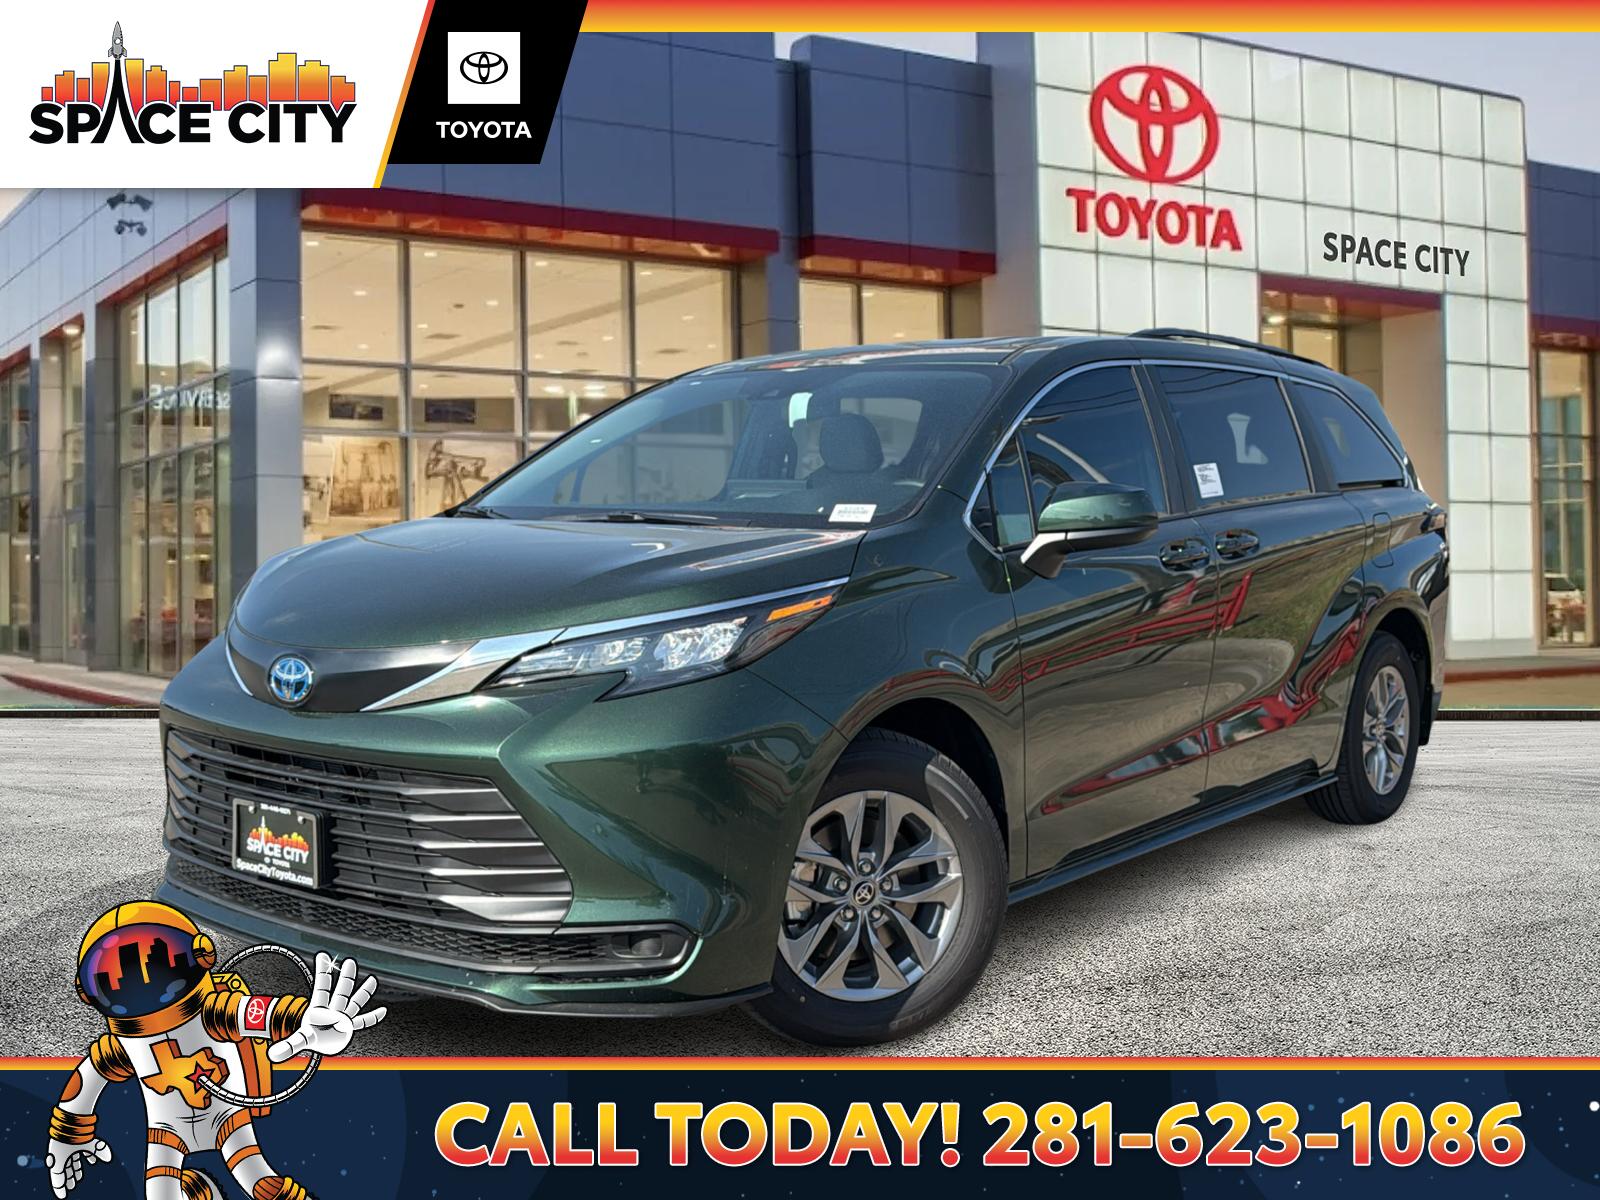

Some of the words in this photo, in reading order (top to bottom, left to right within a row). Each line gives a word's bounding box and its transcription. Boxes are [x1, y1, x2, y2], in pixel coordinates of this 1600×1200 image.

[1066, 188, 1242, 251] TOYOTA
[1323, 232, 1407, 270] SPACE
[1415, 244, 1470, 277] CITY
[246, 837, 282, 858] SPACE
[283, 846, 309, 864] CITY
[236, 857, 314, 886] SpaceCityToyota.com
